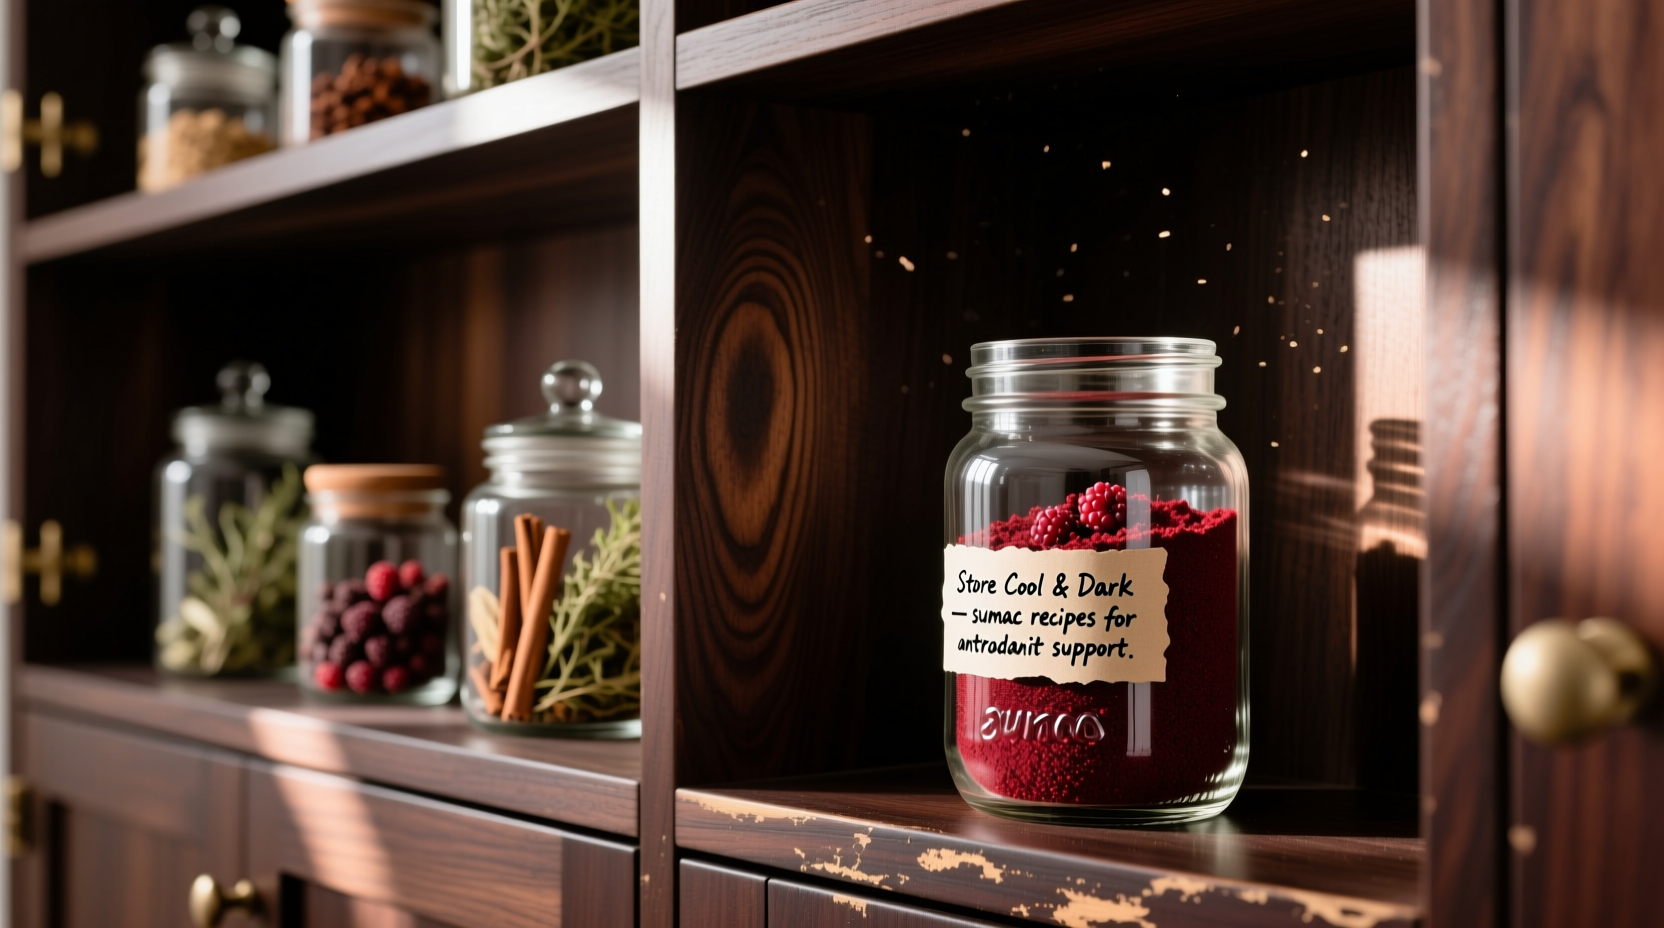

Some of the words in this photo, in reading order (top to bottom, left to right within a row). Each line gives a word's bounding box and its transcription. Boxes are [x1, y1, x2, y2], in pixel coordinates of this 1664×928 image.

[957, 570, 997, 594] Store
[1004, 572, 1045, 597] Cool
[1053, 572, 1070, 599] &
[1078, 572, 1134, 598] Dark
[972, 608, 1023, 626] sumac
[1031, 607, 1096, 635] recipes
[1104, 605, 1138, 632] for
[1052, 637, 1134, 667] support.
